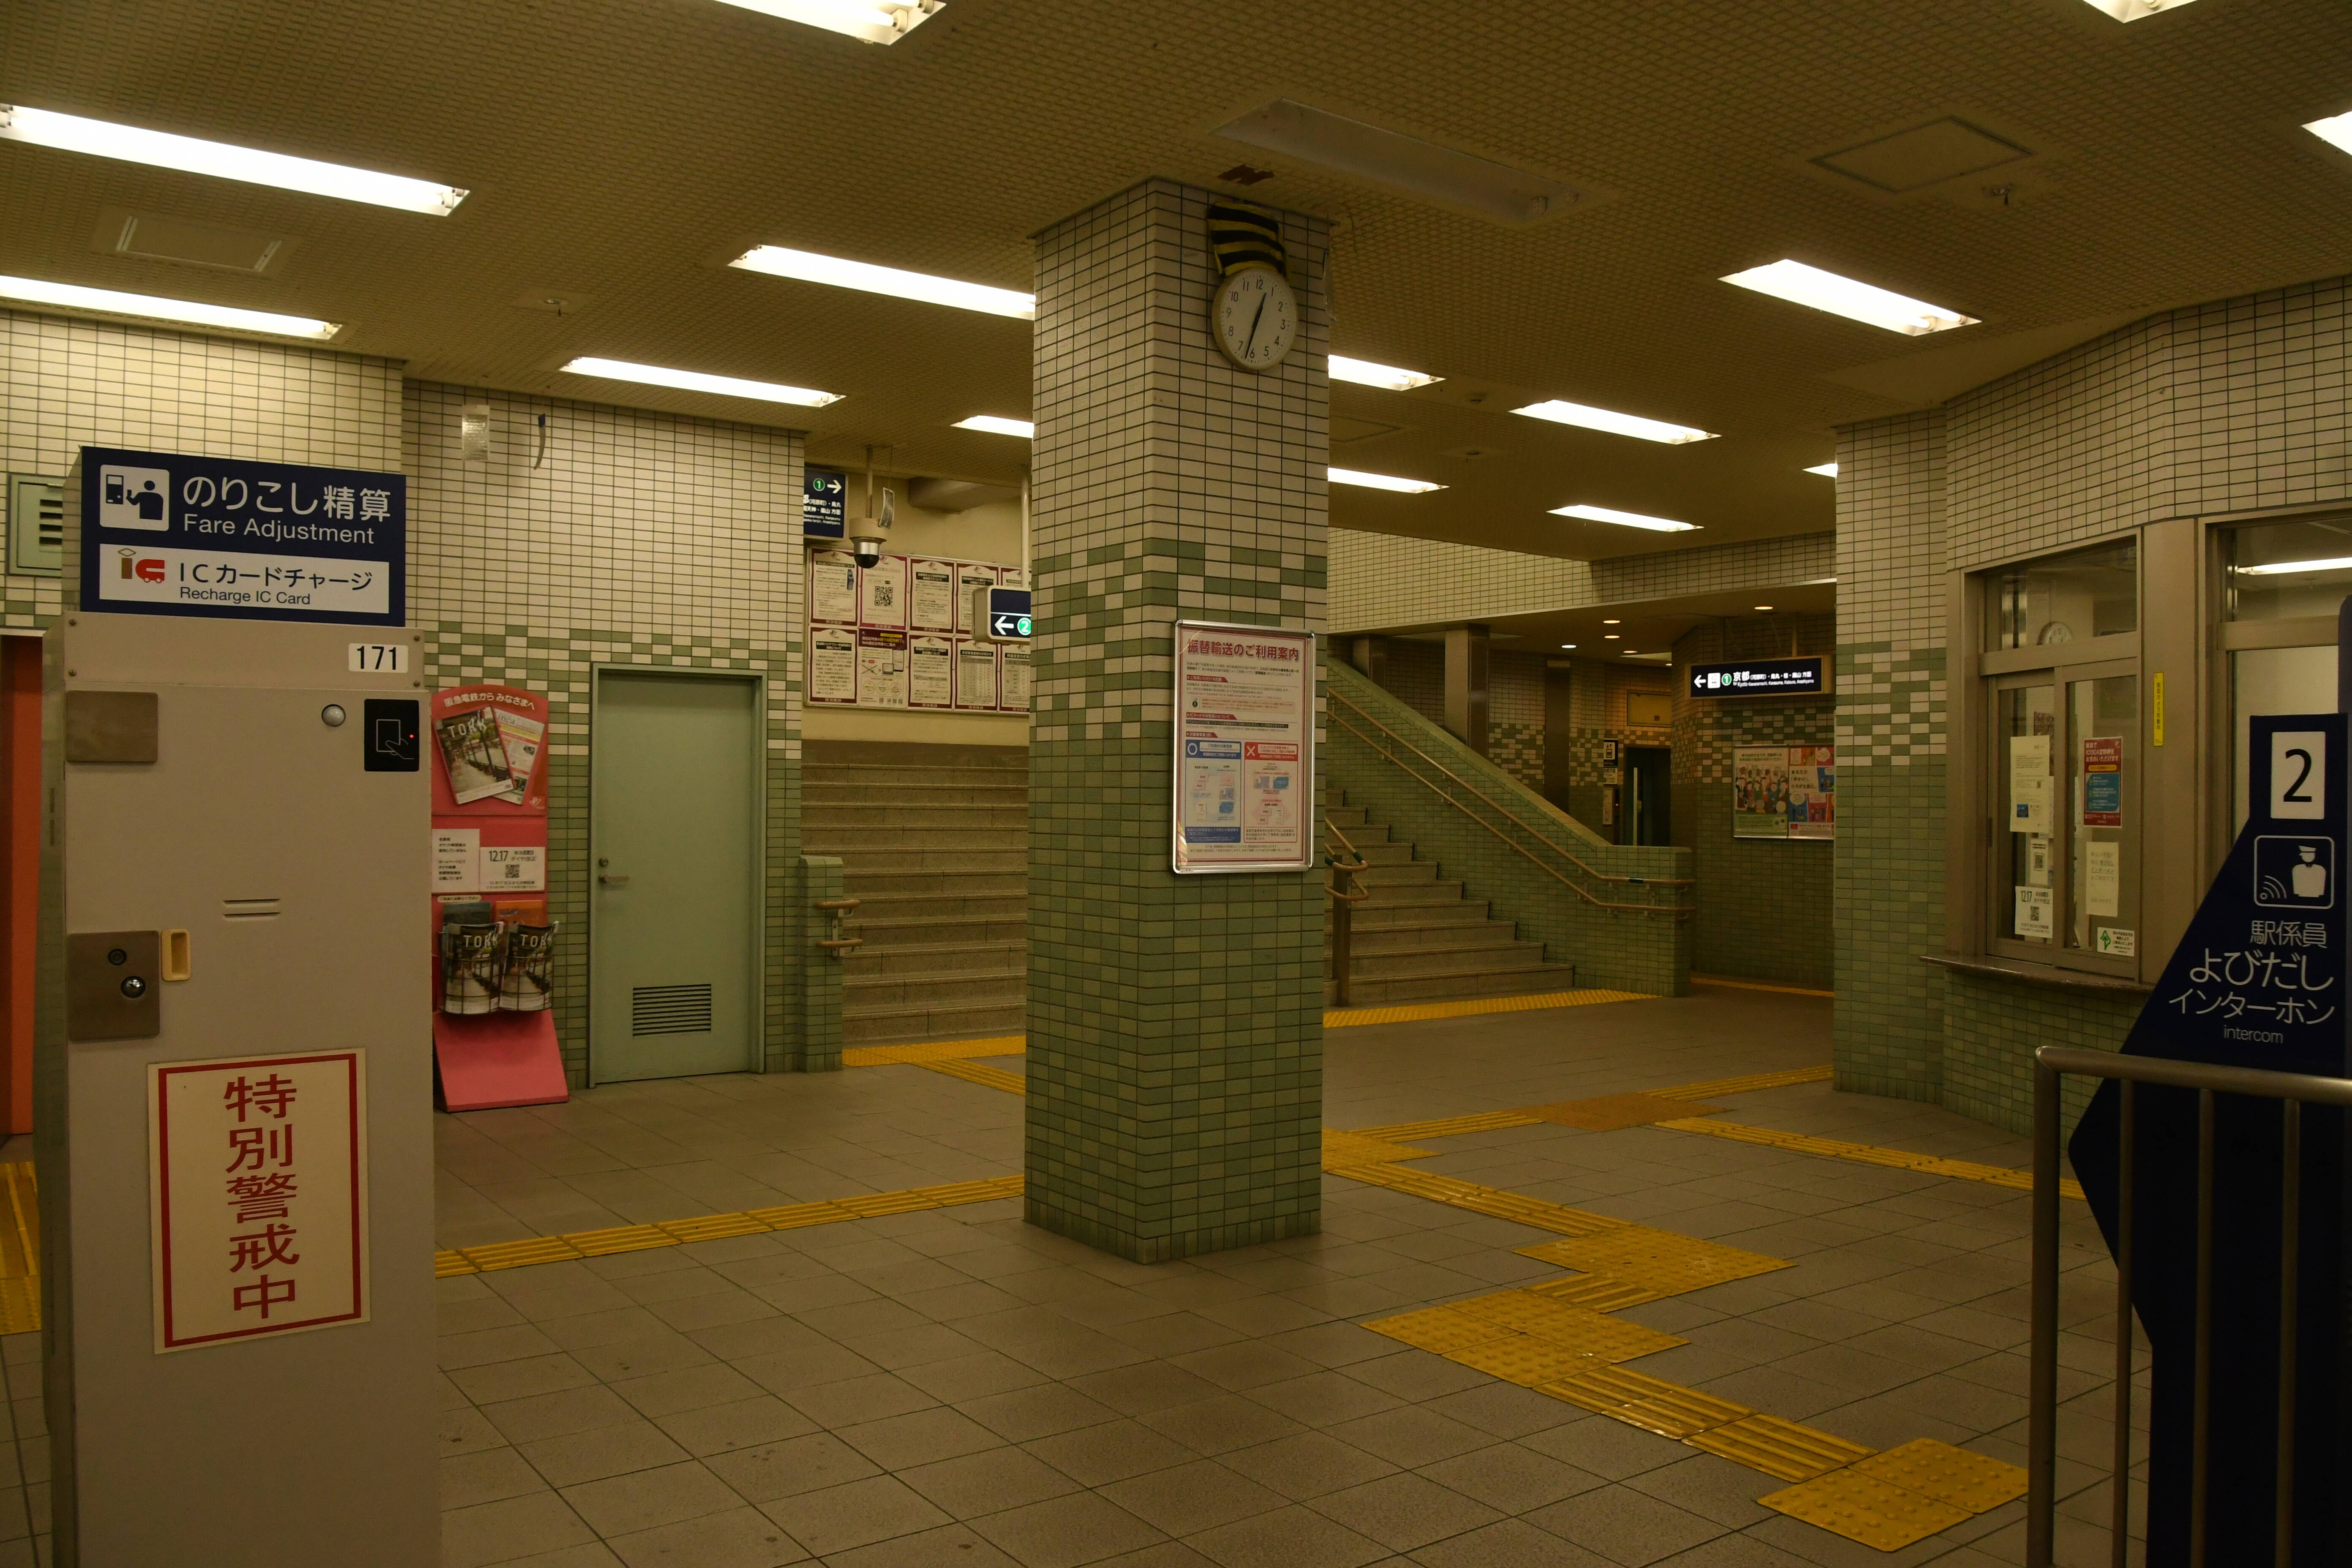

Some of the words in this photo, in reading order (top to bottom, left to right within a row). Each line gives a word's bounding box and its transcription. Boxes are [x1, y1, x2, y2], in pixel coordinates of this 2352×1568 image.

[1243, 281, 1249, 291] 11
[1256, 279, 1263, 290] 12
[1231, 291, 1239, 302] 10
[1271, 287, 1274, 297] 1
[1227, 308, 1232, 318] 9
[1278, 302, 1283, 312] 2
[1228, 326, 1233, 336] 8
[1281, 319, 1285, 329] 3
[1238, 340, 1243, 351] 7
[1274, 336, 1279, 346] 4
[1250, 348, 1255, 359] 6
[1264, 346, 1269, 357] 5
[183, 476, 391, 523] のりこし精算
[183, 514, 235, 535] Fare
[243, 518, 374, 545] Adjustment
[180, 562, 373, 590] ICカードチャージ
[180, 587, 251, 604] Recharge
[256, 591, 271, 603] IC
[276, 591, 310, 605] Card
[356, 645, 397, 670] 171
[1187, 639, 1299, 662] 振替輸送のご利用案内
[495, 693, 535, 710] みなさまへ
[2283, 749, 2313, 803] 2
[489, 850, 509, 862] 12.17
[2250, 920, 2327, 948] 駅係員
[2190, 948, 2334, 991] よびだし
[2169, 988, 2335, 1024] インターホン
[2224, 1025, 2283, 1044] intercom
[223, 1073, 300, 1319] 特別警戒中
